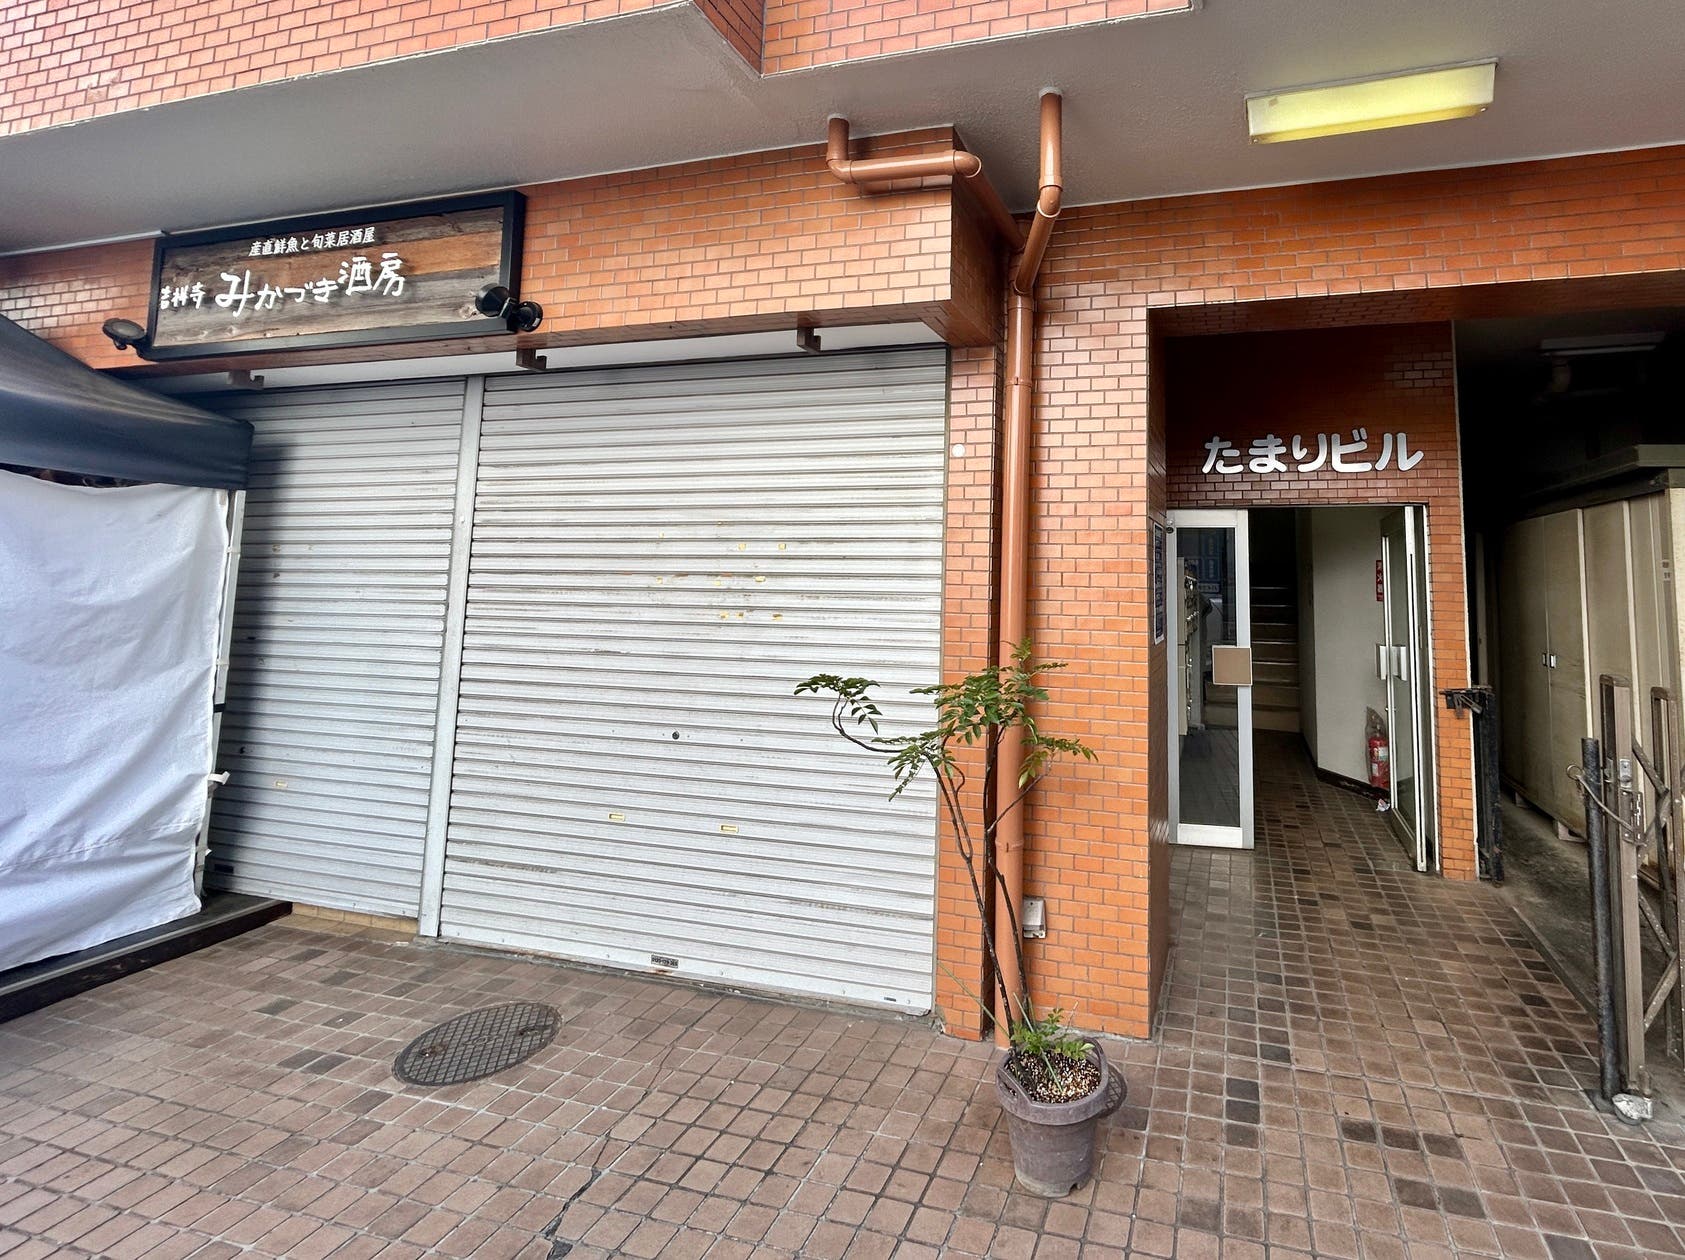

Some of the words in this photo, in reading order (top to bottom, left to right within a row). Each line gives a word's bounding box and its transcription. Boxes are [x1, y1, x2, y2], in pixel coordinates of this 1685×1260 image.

[249, 226, 376, 257] 産直鮮魚と旬菜居酒屋
[160, 281, 206, 310] 吉祥寺
[215, 252, 405, 317] みかづき酒房
[1202, 427, 1424, 474] たまりビル
